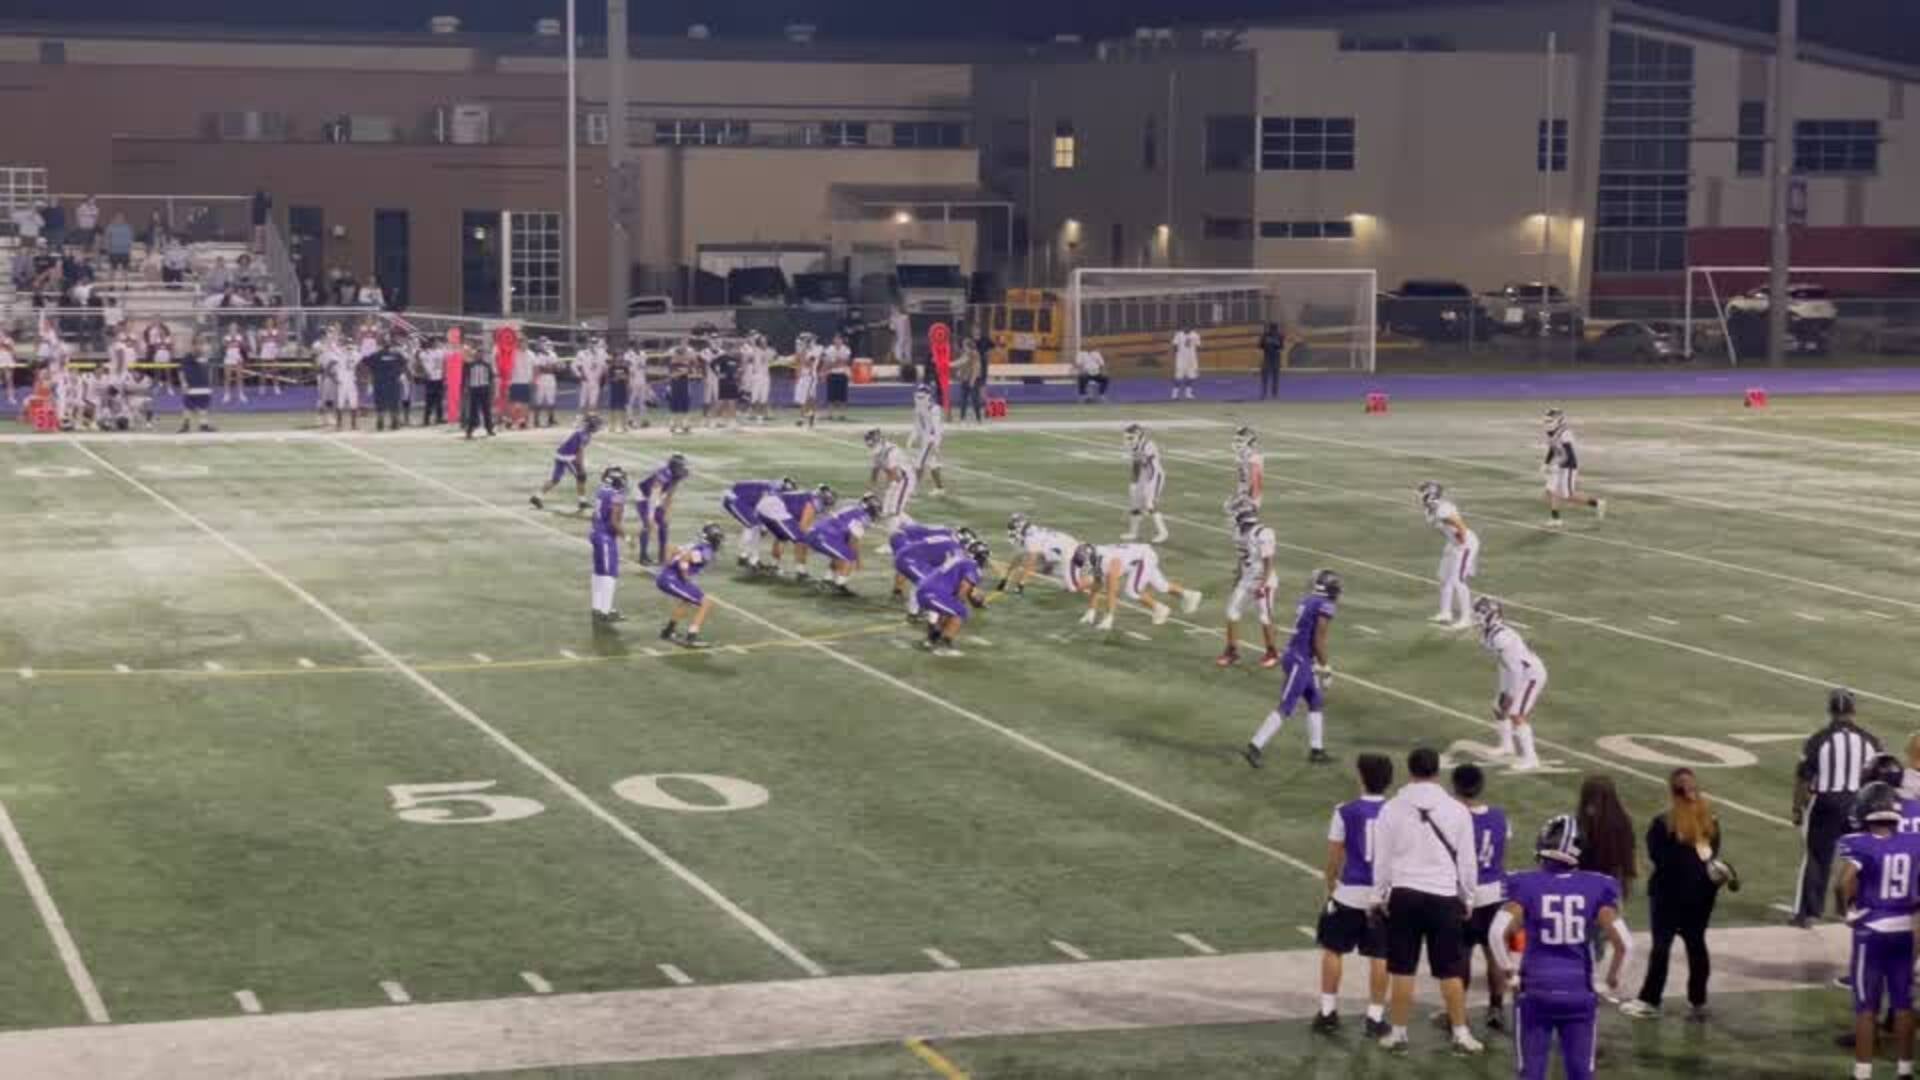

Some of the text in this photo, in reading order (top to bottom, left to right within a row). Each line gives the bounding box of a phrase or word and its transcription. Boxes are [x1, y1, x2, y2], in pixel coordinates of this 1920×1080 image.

[1476, 829, 1495, 869] 4
[1880, 852, 1912, 900] 19
[1541, 893, 1586, 945] 56
